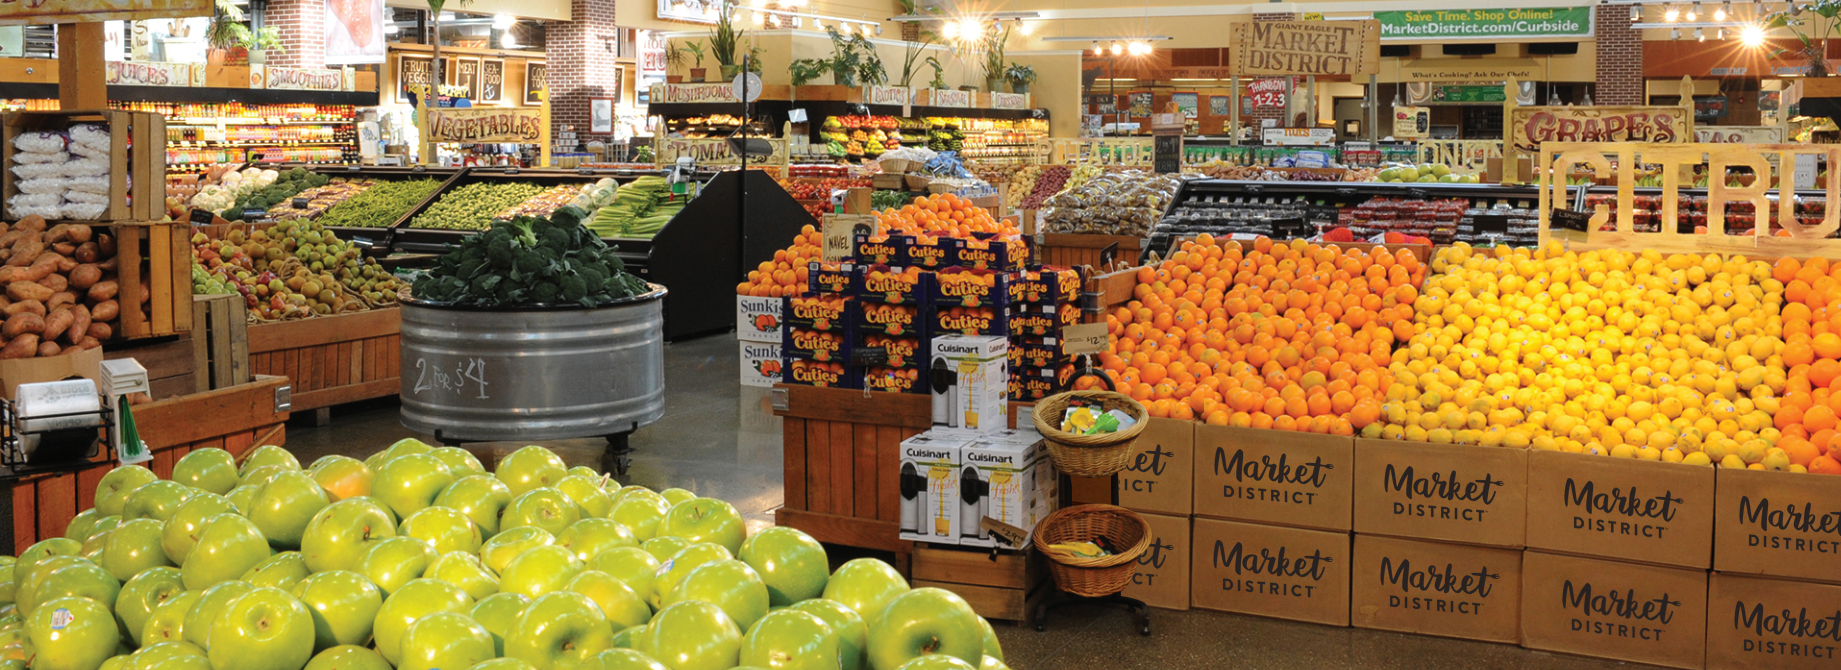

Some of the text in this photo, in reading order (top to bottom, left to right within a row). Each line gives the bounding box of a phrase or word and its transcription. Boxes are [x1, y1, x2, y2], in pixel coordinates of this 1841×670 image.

[1405, 9, 1553, 22] Save Time. Shop Online!
[1275, 22, 1302, 31] GIANT
[1381, 20, 1579, 35] MarketDistrict.com/Curbside
[1250, 22, 1354, 55] MARKET
[403, 59, 432, 73] FRUIT
[458, 62, 477, 75] MEAT
[484, 63, 500, 75] SEA-
[1248, 50, 1352, 74] DISTRICT
[109, 61, 169, 85] JUICES
[269, 68, 340, 90] SMOOTHIES
[1439, 71, 1472, 80] Cooking?
[1711, 67, 1748, 76] SHRIMP
[484, 74, 501, 85] FOOD
[667, 84, 733, 102] MUSHROOMS
[1254, 92, 1286, 106] 1-2-3
[428, 110, 541, 142] VEGETABLES
[1284, 127, 1311, 137] nuts
[1524, 112, 1677, 143] GRAPES
[1038, 138, 1154, 167] POTATOE
[1553, 151, 1841, 239] CITRU
[828, 235, 850, 252] NAVEL
[859, 243, 896, 257] Cuties
[908, 246, 945, 258] Cuties
[958, 249, 996, 262] Cuties
[1008, 247, 1029, 263] Cuties
[818, 274, 850, 285] Cuties
[865, 277, 912, 293] Cuties
[1026, 281, 1048, 293] ties
[1060, 277, 1081, 294] Cuties
[940, 281, 989, 296] Cuties
[1009, 282, 1026, 296] Cuties
[740, 299, 784, 314] Sunkis
[794, 305, 839, 320] Cuties
[865, 309, 912, 324] Cuties
[940, 315, 989, 331] Cuties
[1009, 317, 1026, 330] Cuties
[1025, 316, 1053, 327] uties
[1061, 308, 1081, 324] Cuties
[794, 336, 839, 351] Cuties
[937, 343, 979, 354] Cuisinart
[988, 343, 1005, 353] Cuisinart
[1007, 347, 1024, 360] Cuties
[1025, 348, 1053, 359] uties
[414, 357, 490, 400] 2 FOR $4
[793, 368, 838, 382] Cuties
[866, 373, 912, 389] Cuties
[1027, 379, 1051, 391] ties
[906, 447, 951, 460] Cuisinart
[967, 452, 1013, 465] Cuisinart
[1214, 446, 1334, 488] Market
[1384, 464, 1504, 505] Market
[1223, 485, 1315, 505] DISTRICT
[1564, 478, 1684, 522] Market
[1393, 502, 1486, 522] DISTRICT
[1574, 517, 1666, 539] DISTRICT
[1748, 534, 1840, 554] DISTRICT
[1213, 540, 1333, 581] Market
[1380, 556, 1500, 598] Market
[1222, 578, 1314, 598] DISTRICT
[1389, 595, 1482, 616] DISTRICT
[1562, 580, 1681, 625] Market
[1734, 600, 1841, 641] Market
[1571, 618, 1662, 642] DISTRICT
[1743, 639, 1835, 660] DISTRICT
